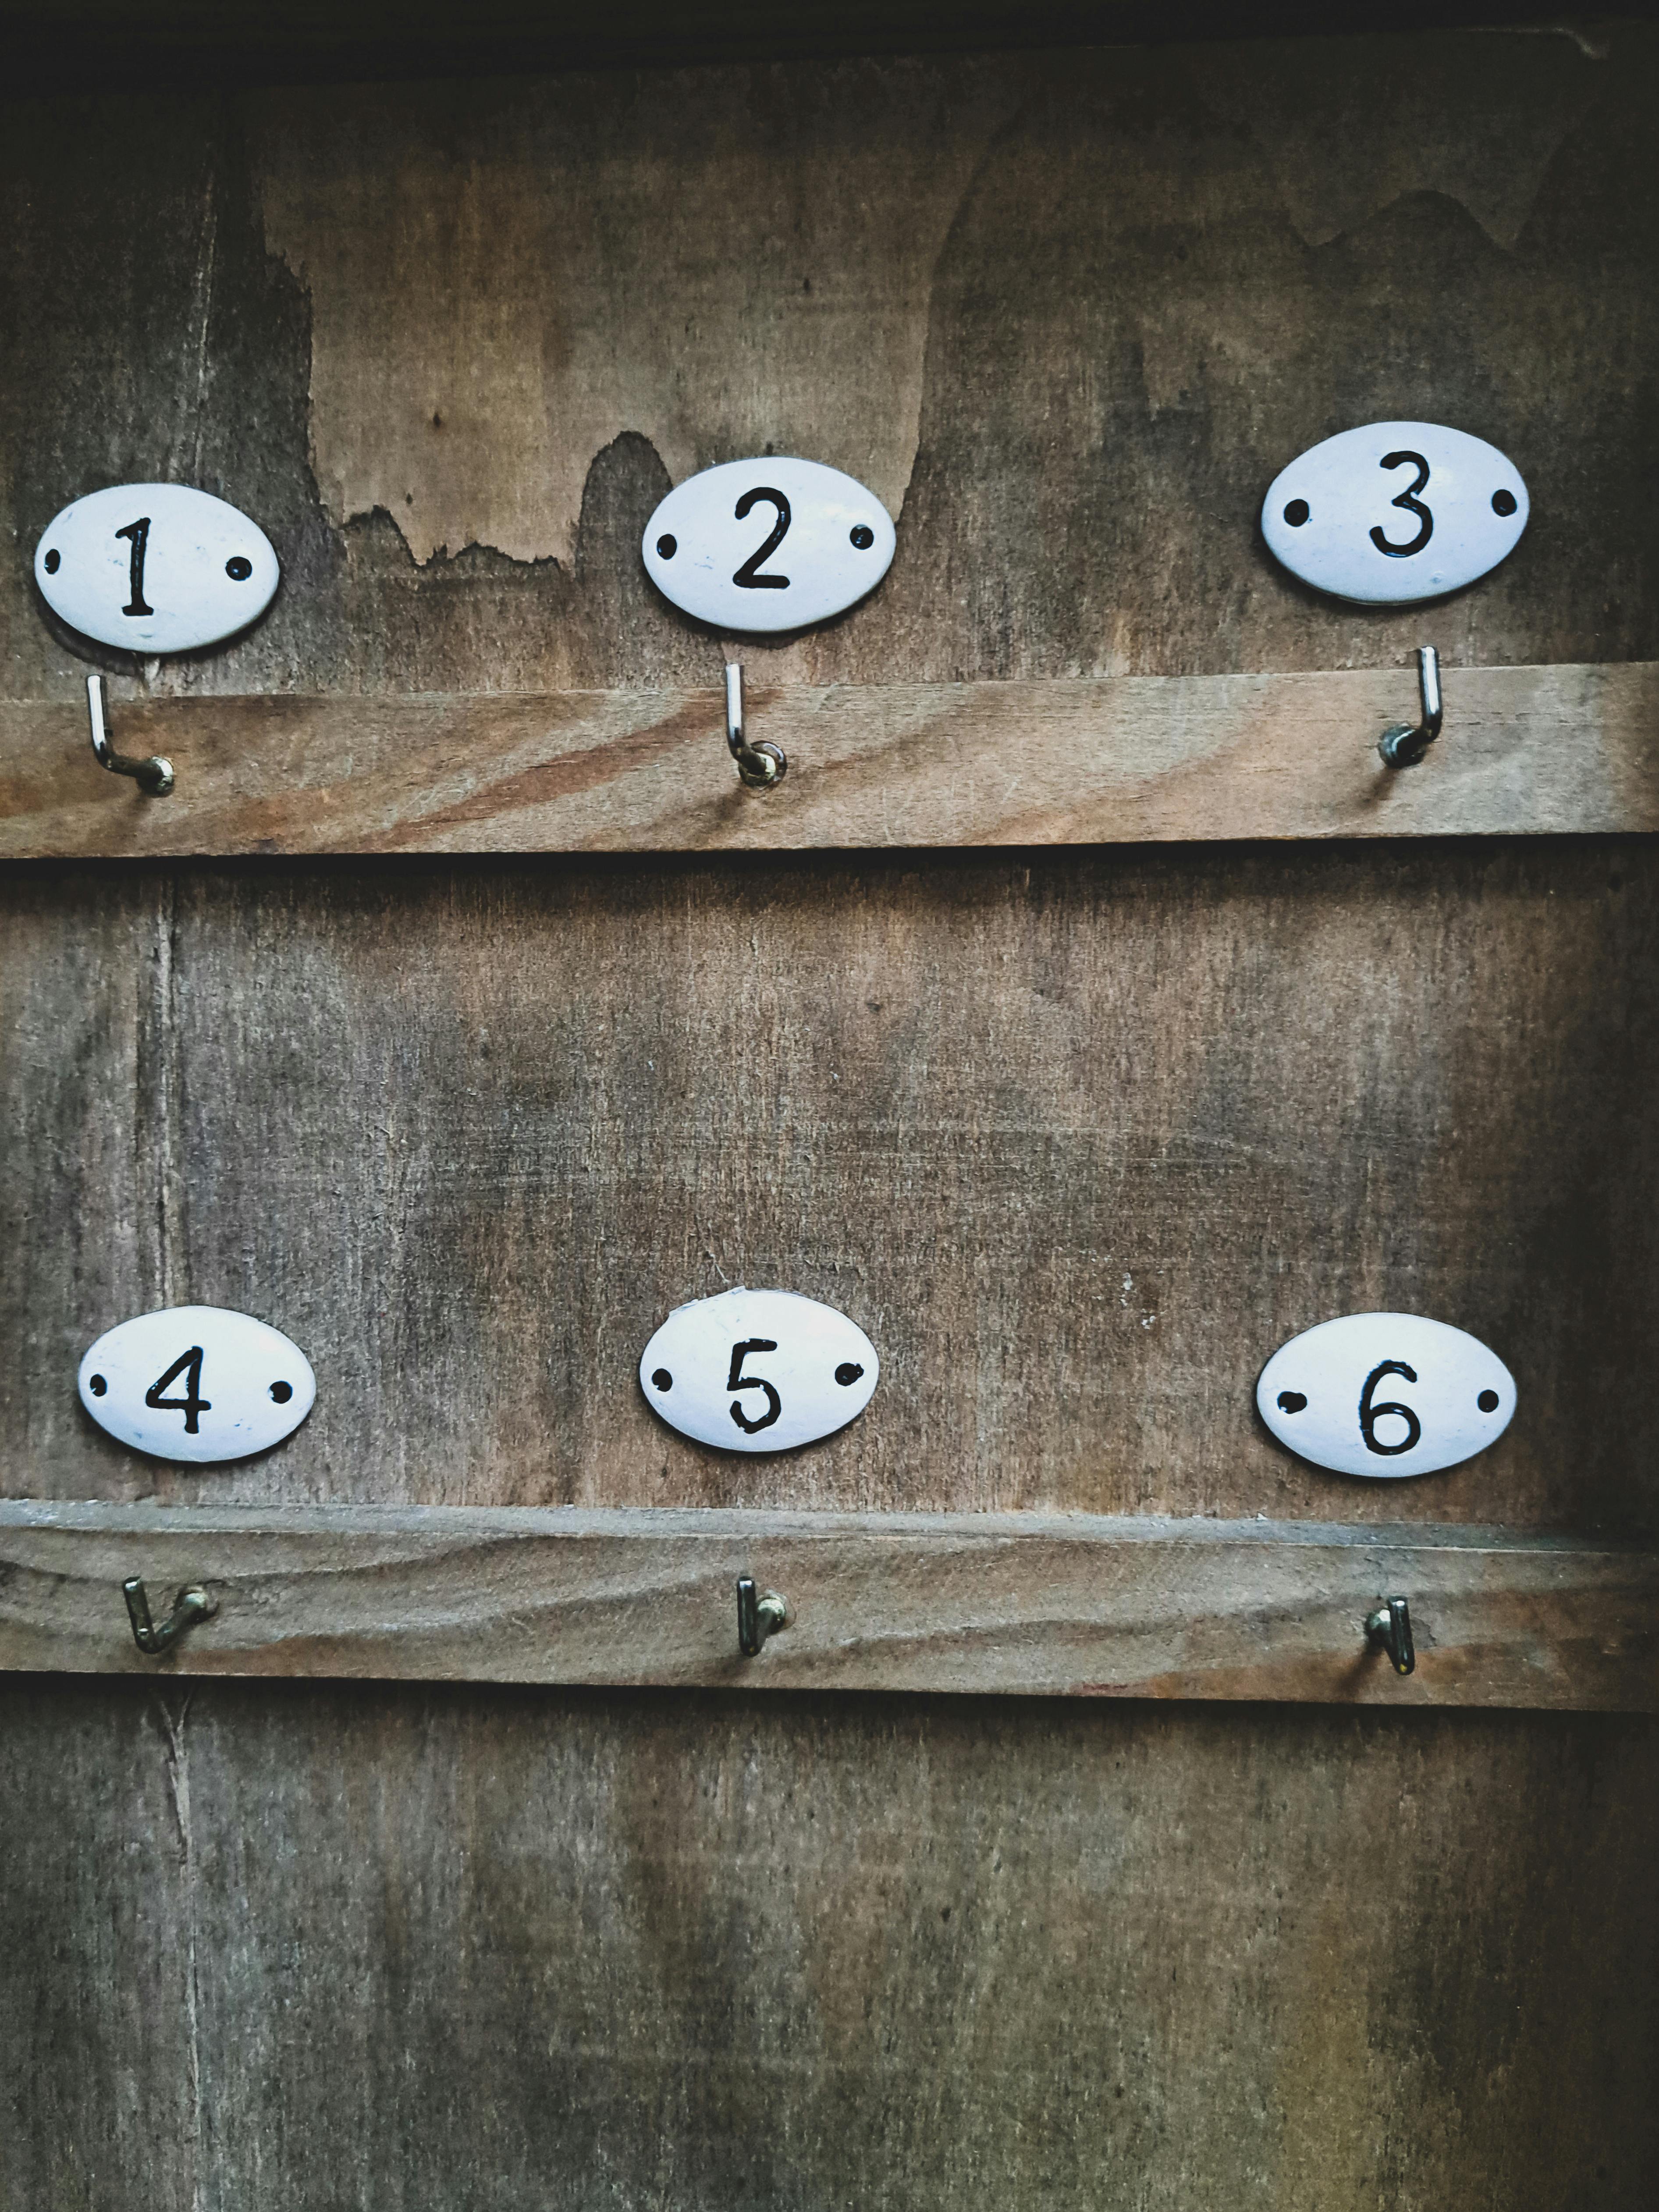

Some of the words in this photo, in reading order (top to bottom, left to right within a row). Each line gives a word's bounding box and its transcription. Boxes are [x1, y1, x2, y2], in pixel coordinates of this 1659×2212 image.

[733, 487, 791, 589] 2
[1370, 451, 1433, 558] 3
[115, 518, 154, 616] 1
[146, 1346, 211, 1434] 4
[727, 1338, 781, 1434] 5
[1359, 1360, 1421, 1455] 6
